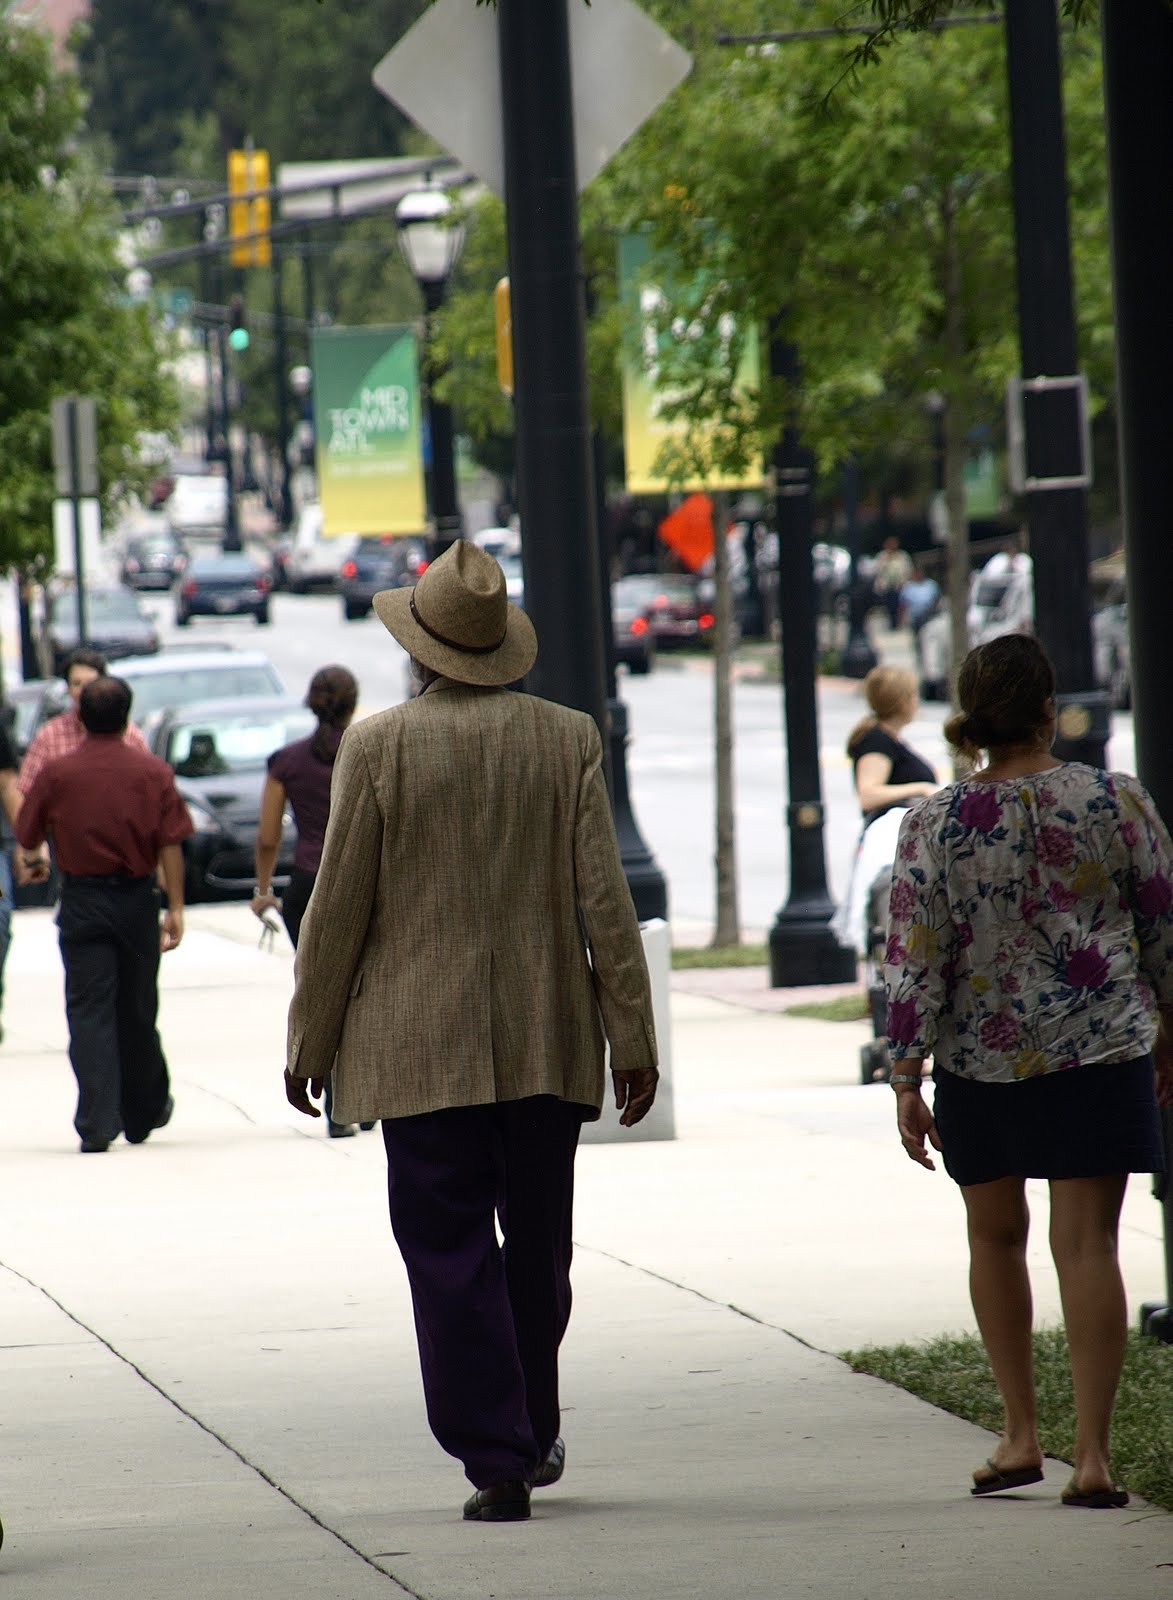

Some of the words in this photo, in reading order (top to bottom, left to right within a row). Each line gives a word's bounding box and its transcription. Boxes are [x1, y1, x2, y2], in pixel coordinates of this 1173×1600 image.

[361, 385, 409, 410] MID
[328, 408, 410, 432] TOWN
[328, 430, 376, 455] ATL
